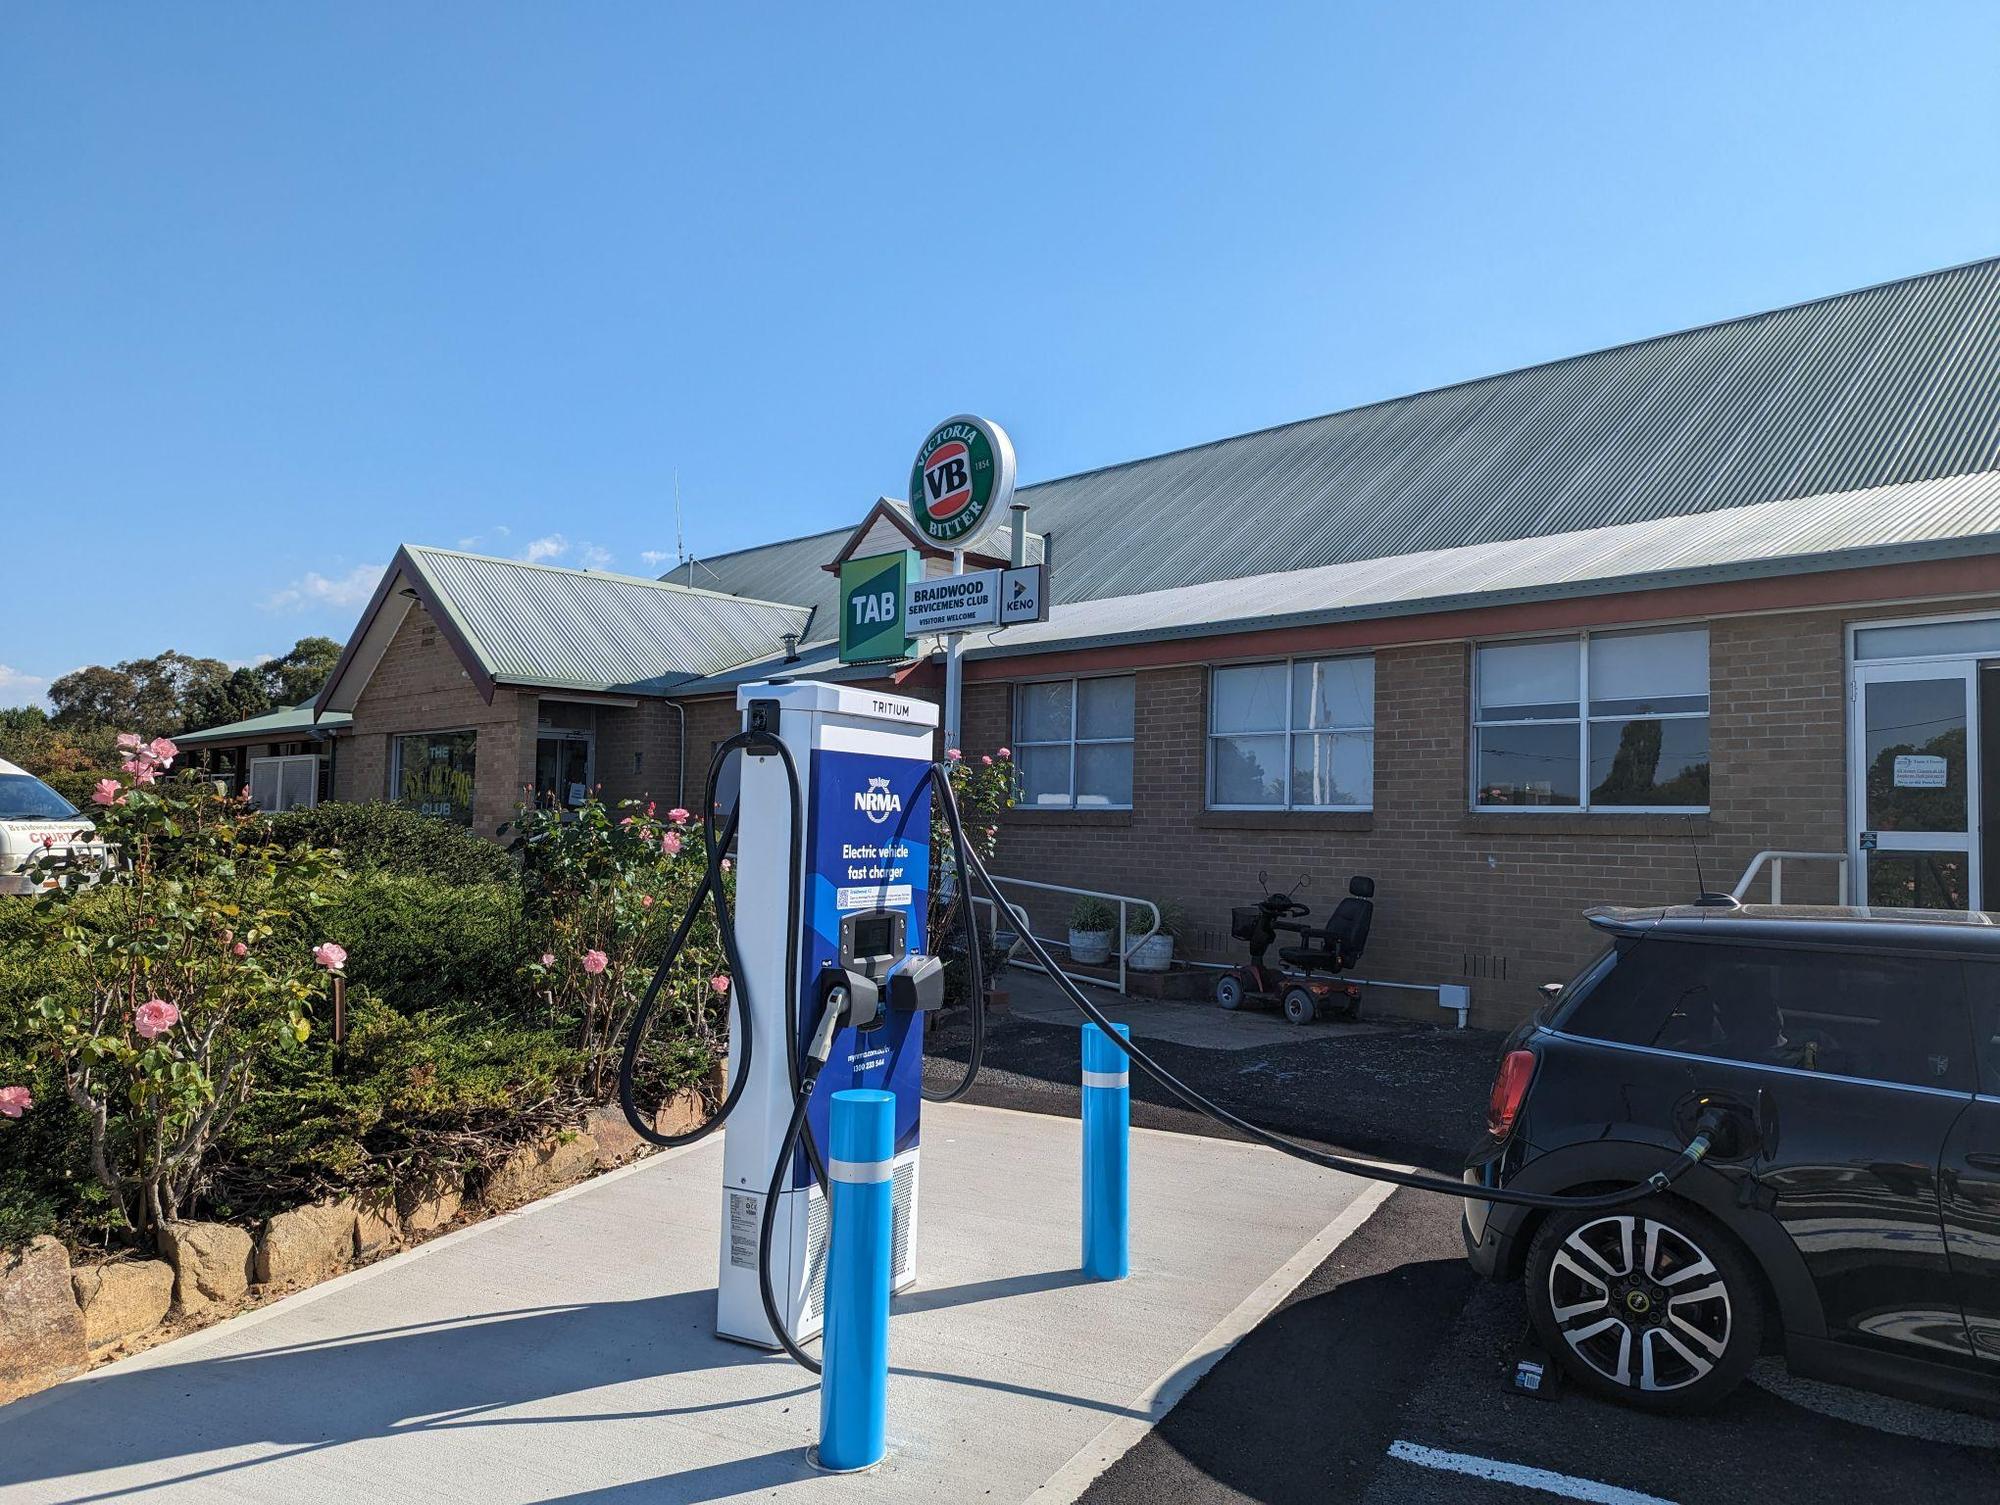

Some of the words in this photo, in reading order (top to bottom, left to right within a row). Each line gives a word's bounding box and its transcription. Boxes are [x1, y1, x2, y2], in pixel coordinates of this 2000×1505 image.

[918, 425, 977, 466] VICTORIA
[925, 458, 968, 500] VB
[928, 501, 983, 537] BITTER
[914, 581, 984, 603] BRAIDWOOD
[852, 591, 895, 625] TAB
[908, 599, 965, 615] SERVICEMENS
[966, 595, 989, 607] CLUB
[1006, 599, 1034, 611] KENO
[919, 615, 946, 626] VISITORS
[946, 611, 976, 622] WELCOME
[873, 700, 910, 717] TRITIUM
[430, 746, 450, 758] THE
[854, 792, 902, 813] NRMA
[843, 844, 877, 859] Electric
[879, 844, 909, 858] vehicle
[848, 865, 868, 880] fast
[869, 864, 904, 882] charger
